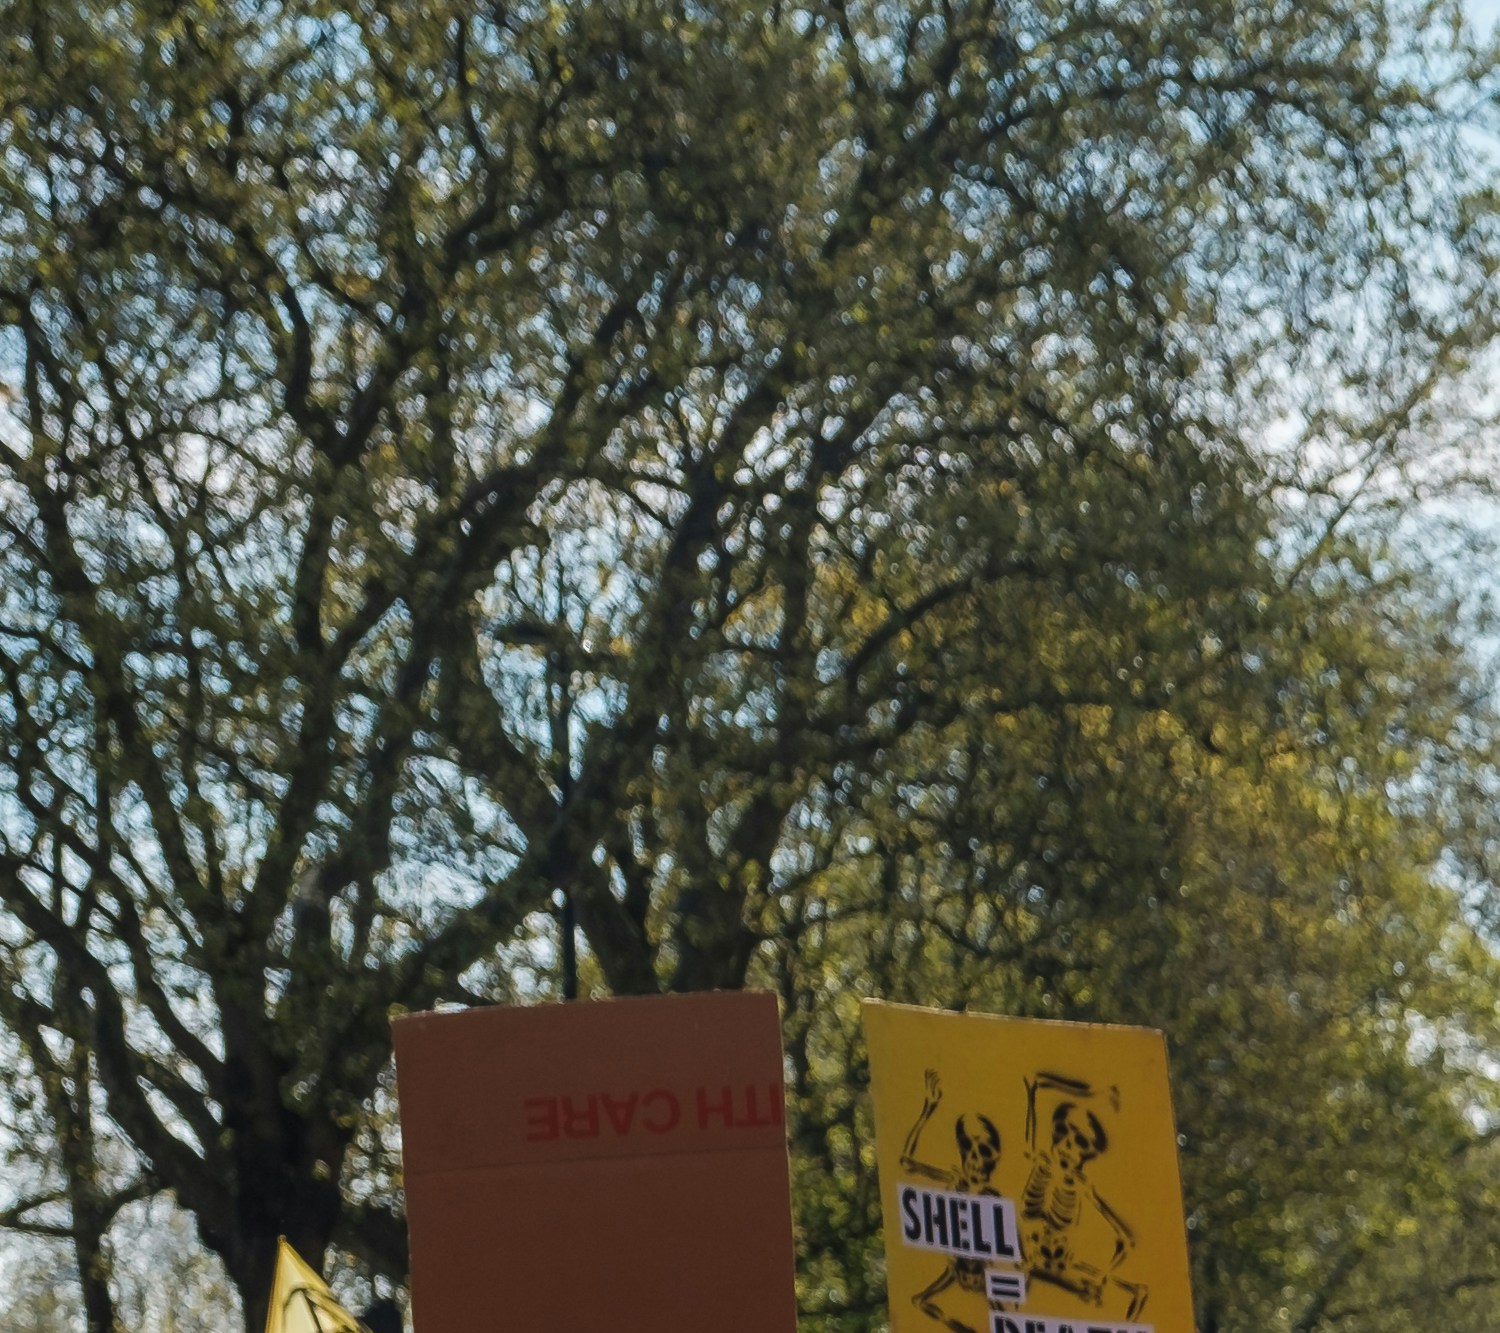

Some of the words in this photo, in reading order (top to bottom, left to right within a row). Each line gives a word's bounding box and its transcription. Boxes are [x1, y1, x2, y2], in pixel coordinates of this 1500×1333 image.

[524, 1088, 681, 1143] CARE
[697, 1083, 784, 1130] ITH
[901, 1186, 1015, 1257] SHELL
